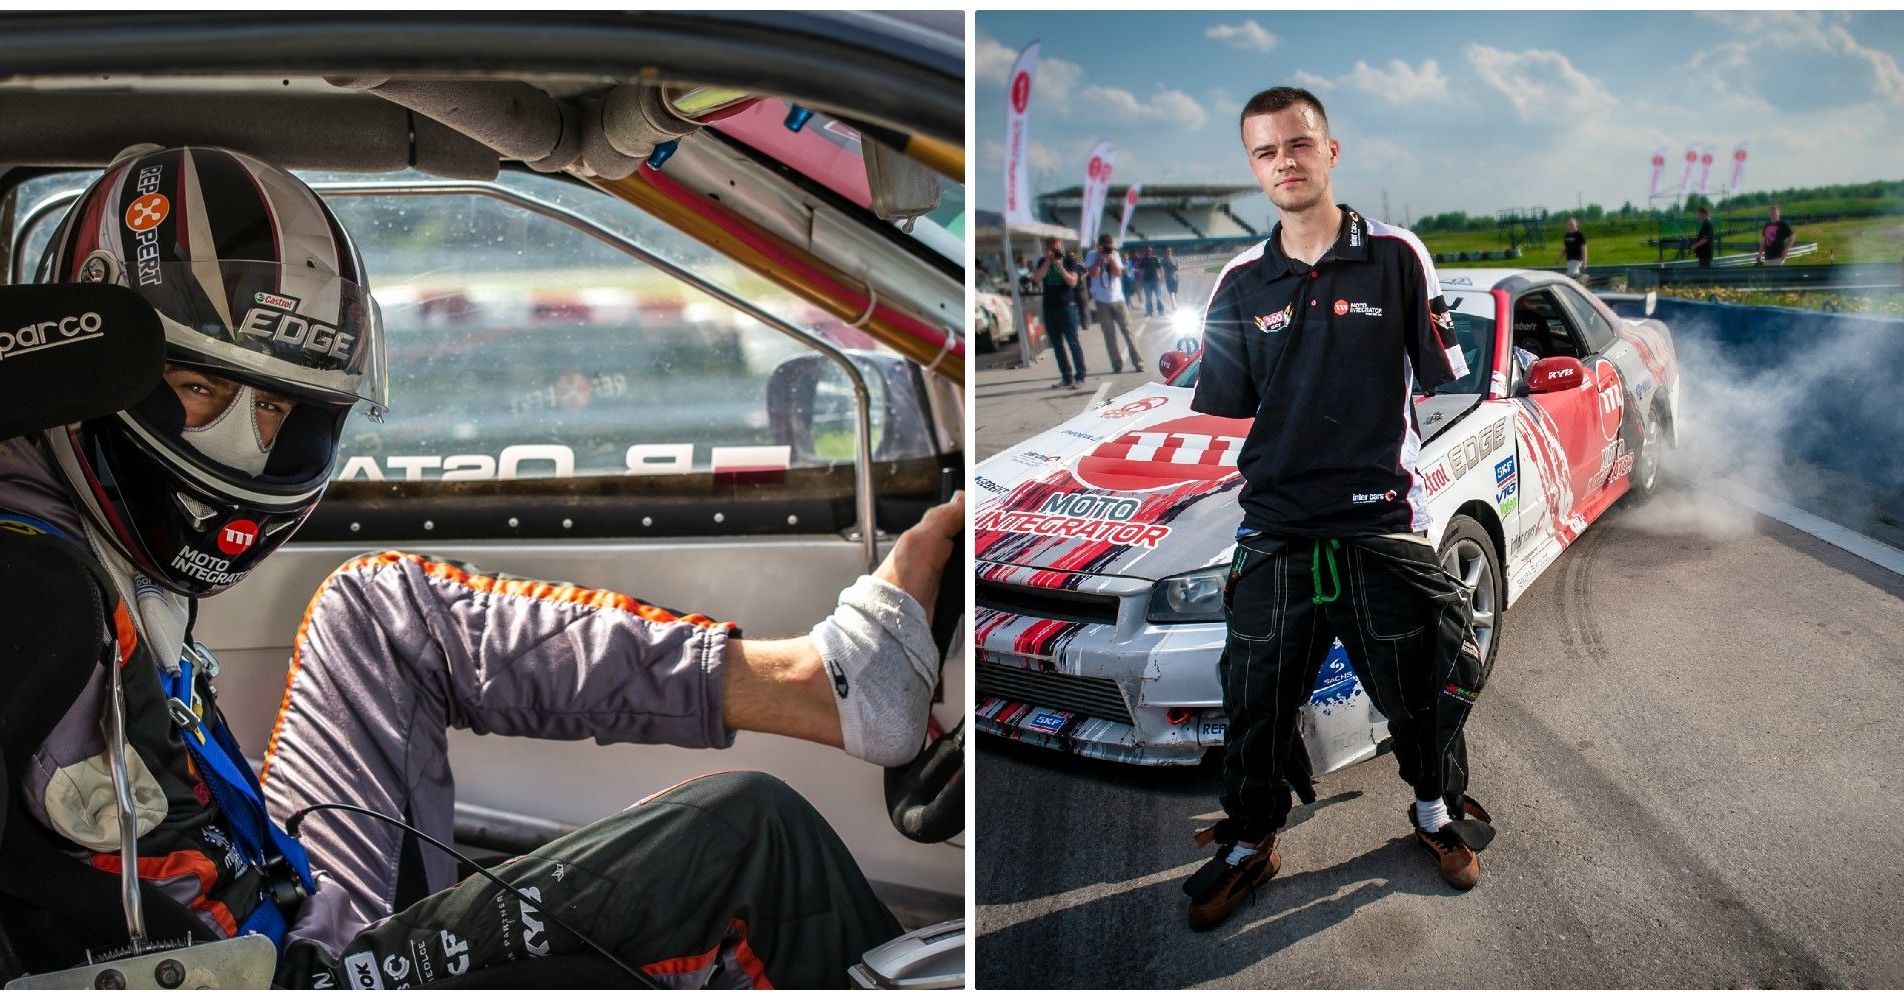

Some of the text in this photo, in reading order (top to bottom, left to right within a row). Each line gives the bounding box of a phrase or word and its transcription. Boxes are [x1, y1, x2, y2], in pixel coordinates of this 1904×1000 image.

[264, 295, 293, 309] Castrol
[238, 308, 356, 360] EDGE
[1447, 415, 1506, 480] EDGE
[1497, 459, 1513, 479] SKF
[1040, 492, 1141, 522] MOTO
[975, 510, 1171, 549] INTEGRATOR
[180, 545, 230, 572] MOTO
[1323, 671, 1353, 685] SACHS
[1035, 716, 1061, 726] SKF
